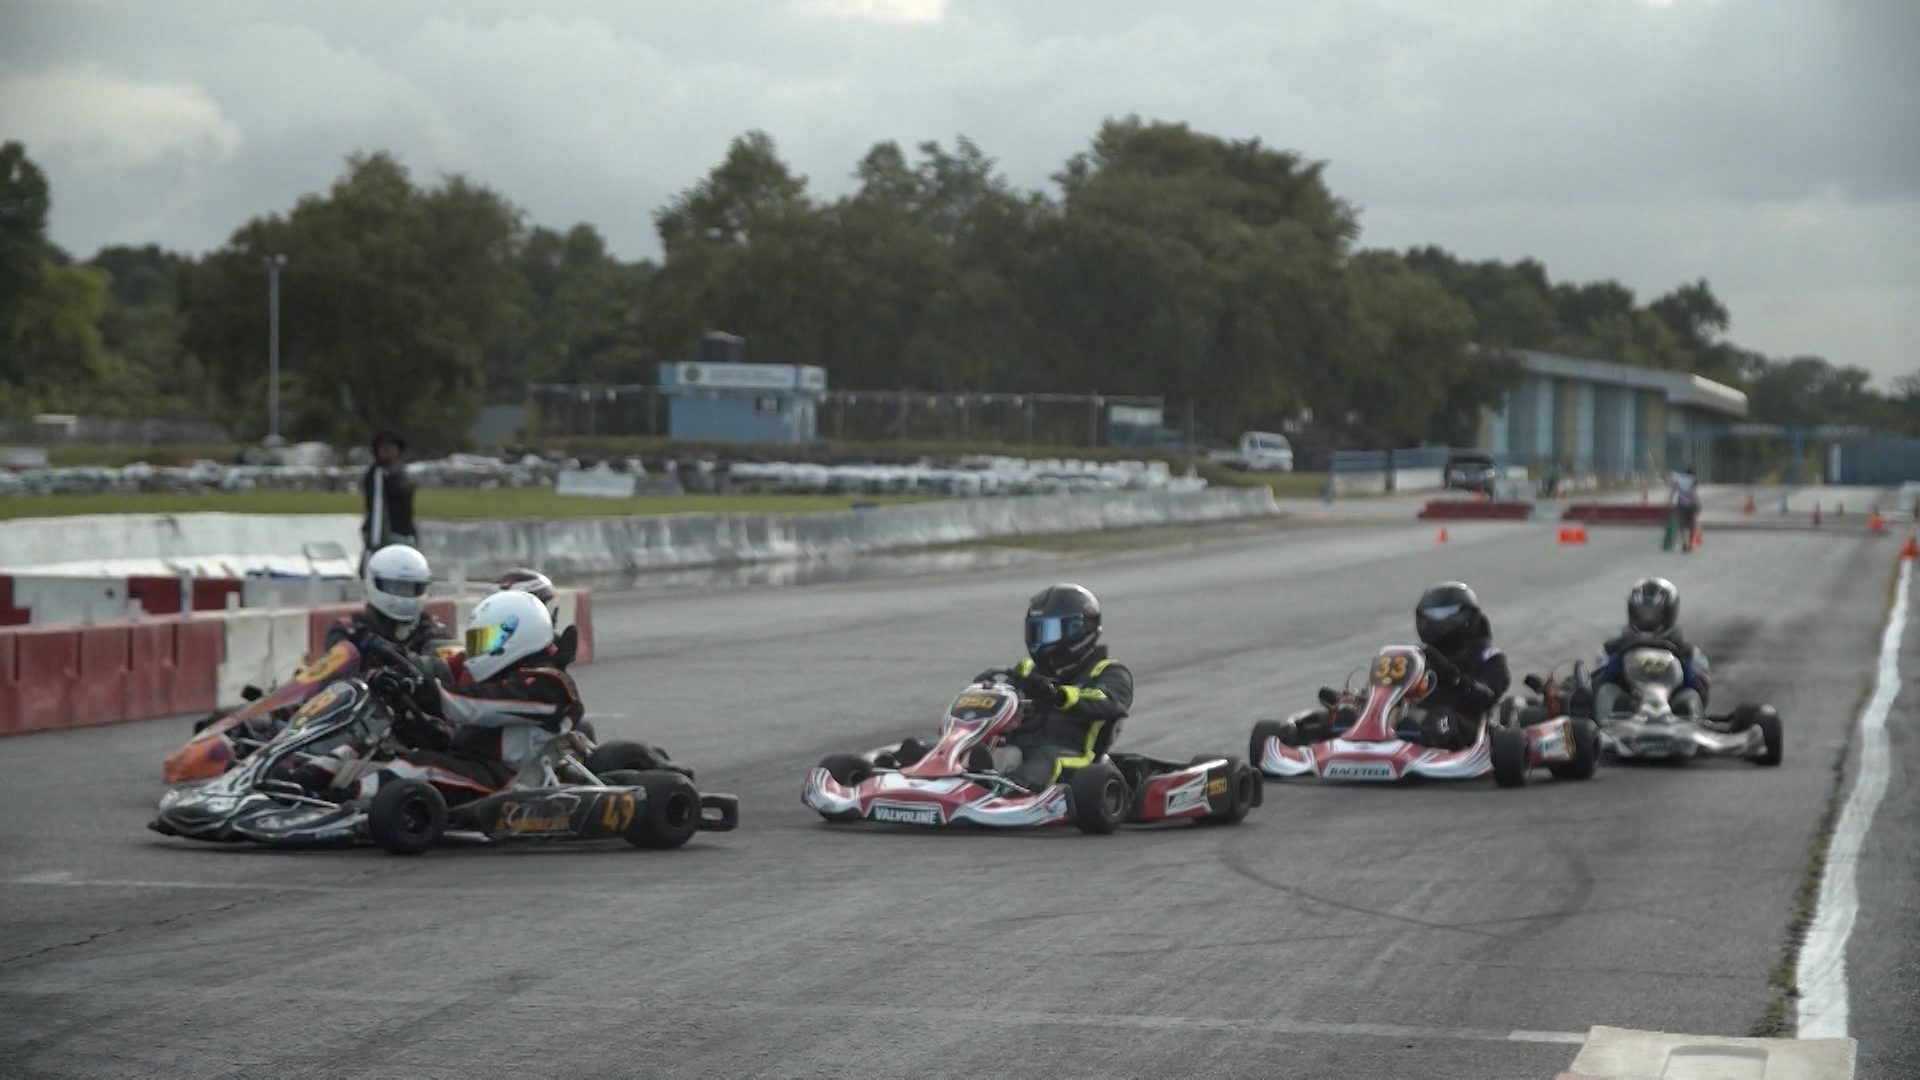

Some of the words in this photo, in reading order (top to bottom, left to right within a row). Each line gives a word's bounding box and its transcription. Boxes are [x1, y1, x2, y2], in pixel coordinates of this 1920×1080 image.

[1374, 656, 1408, 679] 33
[603, 794, 636, 831] 49
[875, 807, 937, 824] VALVOLINE
